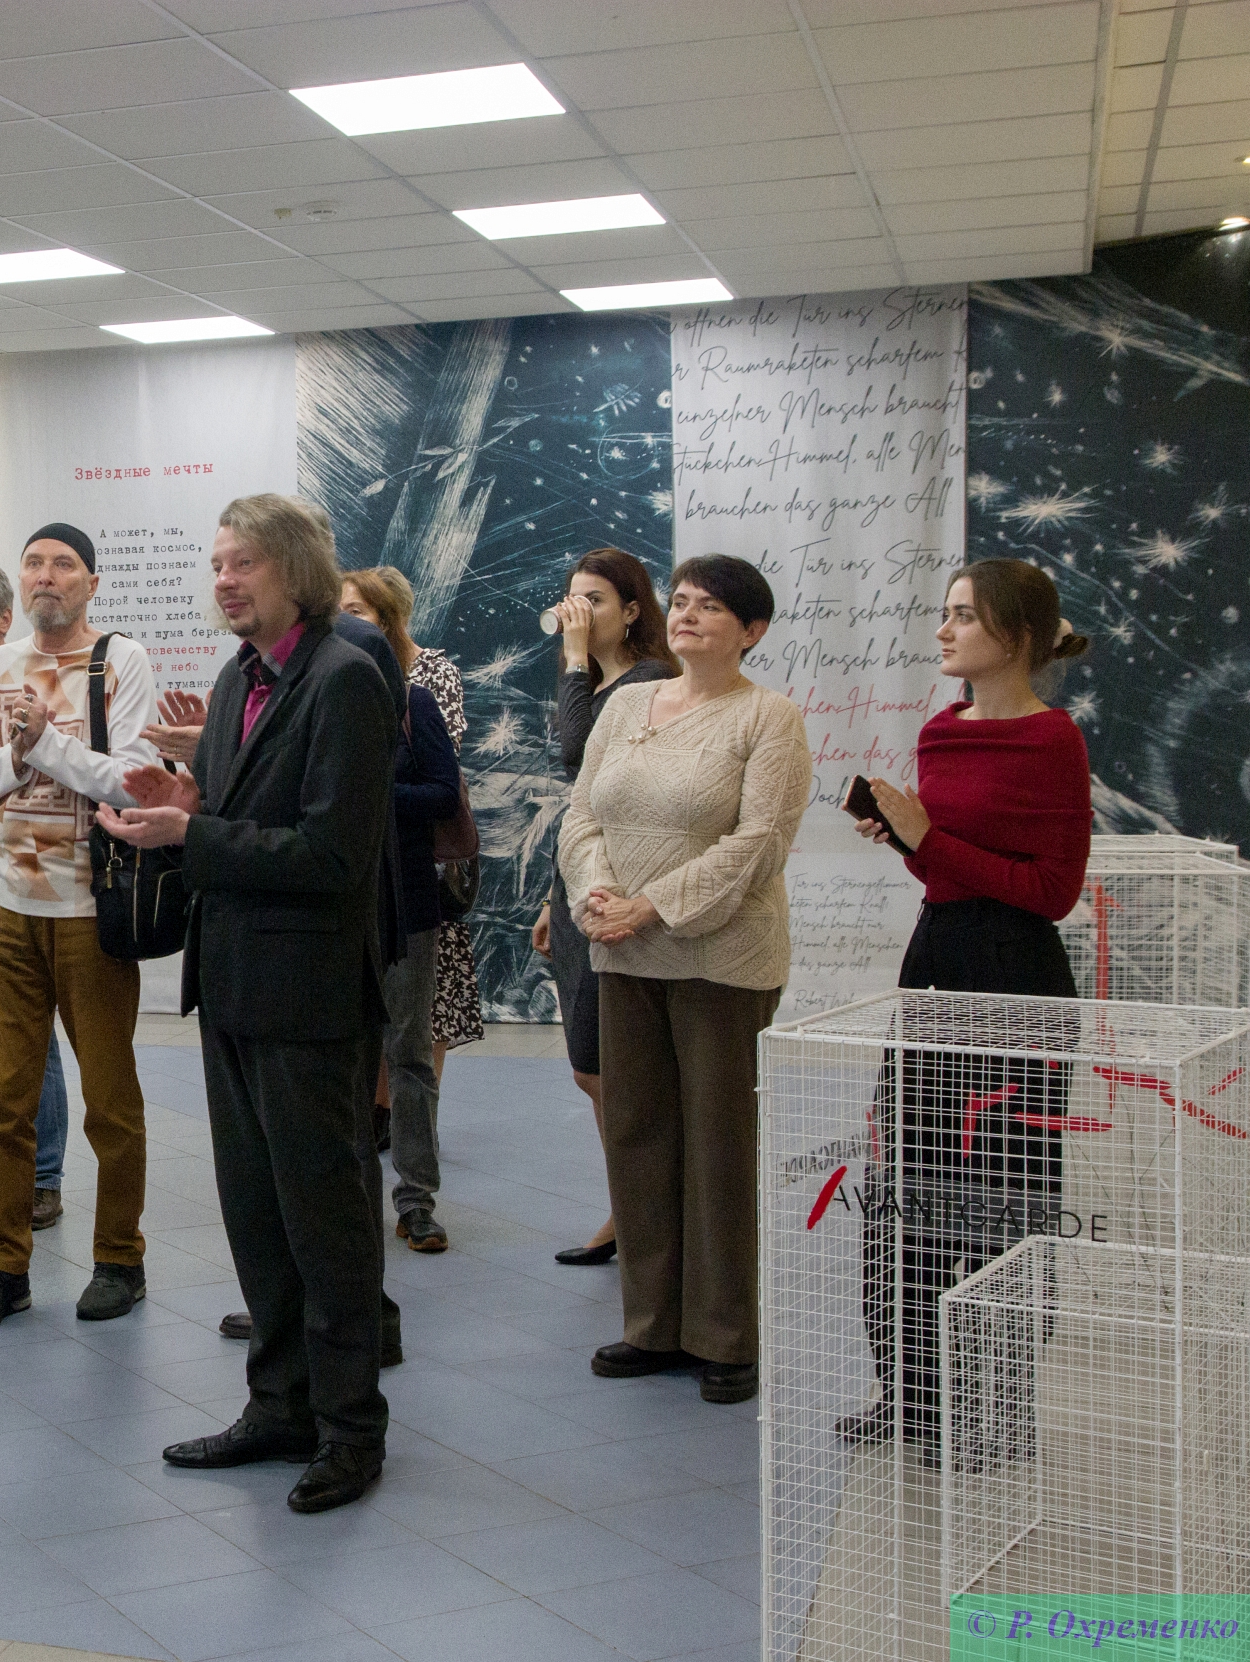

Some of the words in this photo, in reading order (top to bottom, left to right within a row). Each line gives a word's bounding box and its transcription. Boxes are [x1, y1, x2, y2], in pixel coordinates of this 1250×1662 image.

[750, 301, 779, 337] die
[787, 294, 833, 338] Tür
[838, 303, 874, 327] ins
[699, 343, 839, 391] Raumraketen
[677, 393, 771, 441] einzelner
[779, 385, 878, 434] Mensch
[866, 431, 900, 472] alle
[74, 467, 151, 480] Звёздные
[163, 463, 214, 476] мечты
[685, 487, 778, 521] brauchen
[785, 487, 822, 523] das
[822, 494, 897, 533] ganze
[99, 529, 107, 538] А
[113, 528, 155, 538] может,
[163, 527, 184, 536] мы,
[95, 545, 145, 556] ознавая
[153, 543, 203, 553] космос,
[96, 563, 140, 573] днажды
[146, 561, 197, 570] познаем
[790, 537, 833, 588] Tür
[840, 557, 876, 580] ins
[111, 579, 139, 588] сами
[146, 576, 183, 587] себя?
[94, 595, 129, 608] Порой
[136, 595, 195, 605] человеку
[88, 613, 158, 624] достаточно
[154, 630, 184, 640] шума
[146, 645, 218, 656] ловечеству
[171, 662, 199, 671] небо
[782, 638, 881, 683] Mensch
[885, 637, 943, 669] brauc
[862, 736, 902, 772] das
[807, 1165, 1108, 1243] AVANTGARDE
